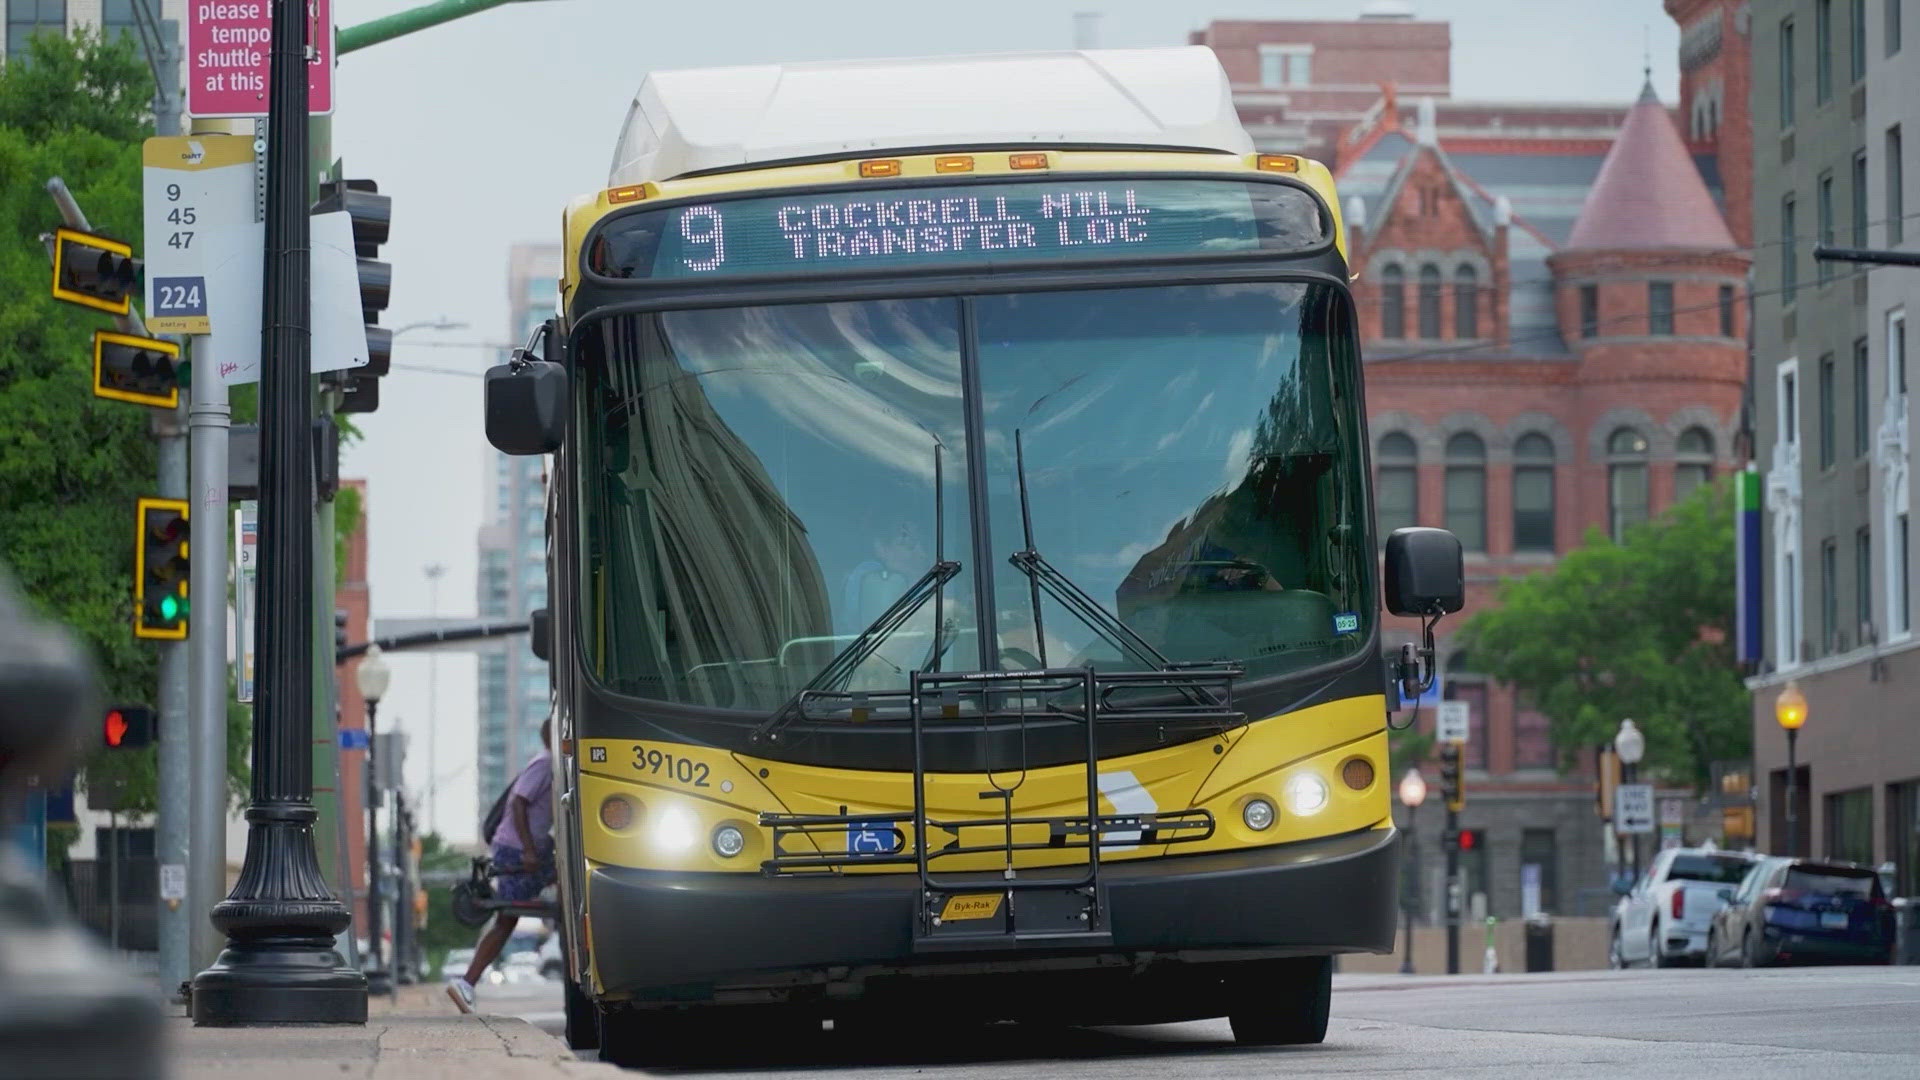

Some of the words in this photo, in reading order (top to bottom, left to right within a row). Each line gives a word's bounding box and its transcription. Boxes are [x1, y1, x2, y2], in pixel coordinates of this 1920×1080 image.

[199, 1, 260, 24] please
[211, 26, 271, 48] tempo
[198, 48, 261, 68] shuttle
[206, 73, 224, 91] at
[231, 71, 264, 90] this
[166, 184, 181, 201] 9
[167, 207, 196, 225] 45
[778, 196, 1021, 232] COCKRELL
[168, 231, 194, 249] 47
[681, 205, 725, 272] 9
[784, 222, 1036, 259] TRANSFER
[1058, 217, 1147, 246] LOC
[160, 285, 201, 309] 224
[592, 748, 606, 761] APC
[631, 745, 710, 787] 39102
[954, 901, 991, 911] Byk-Rak
